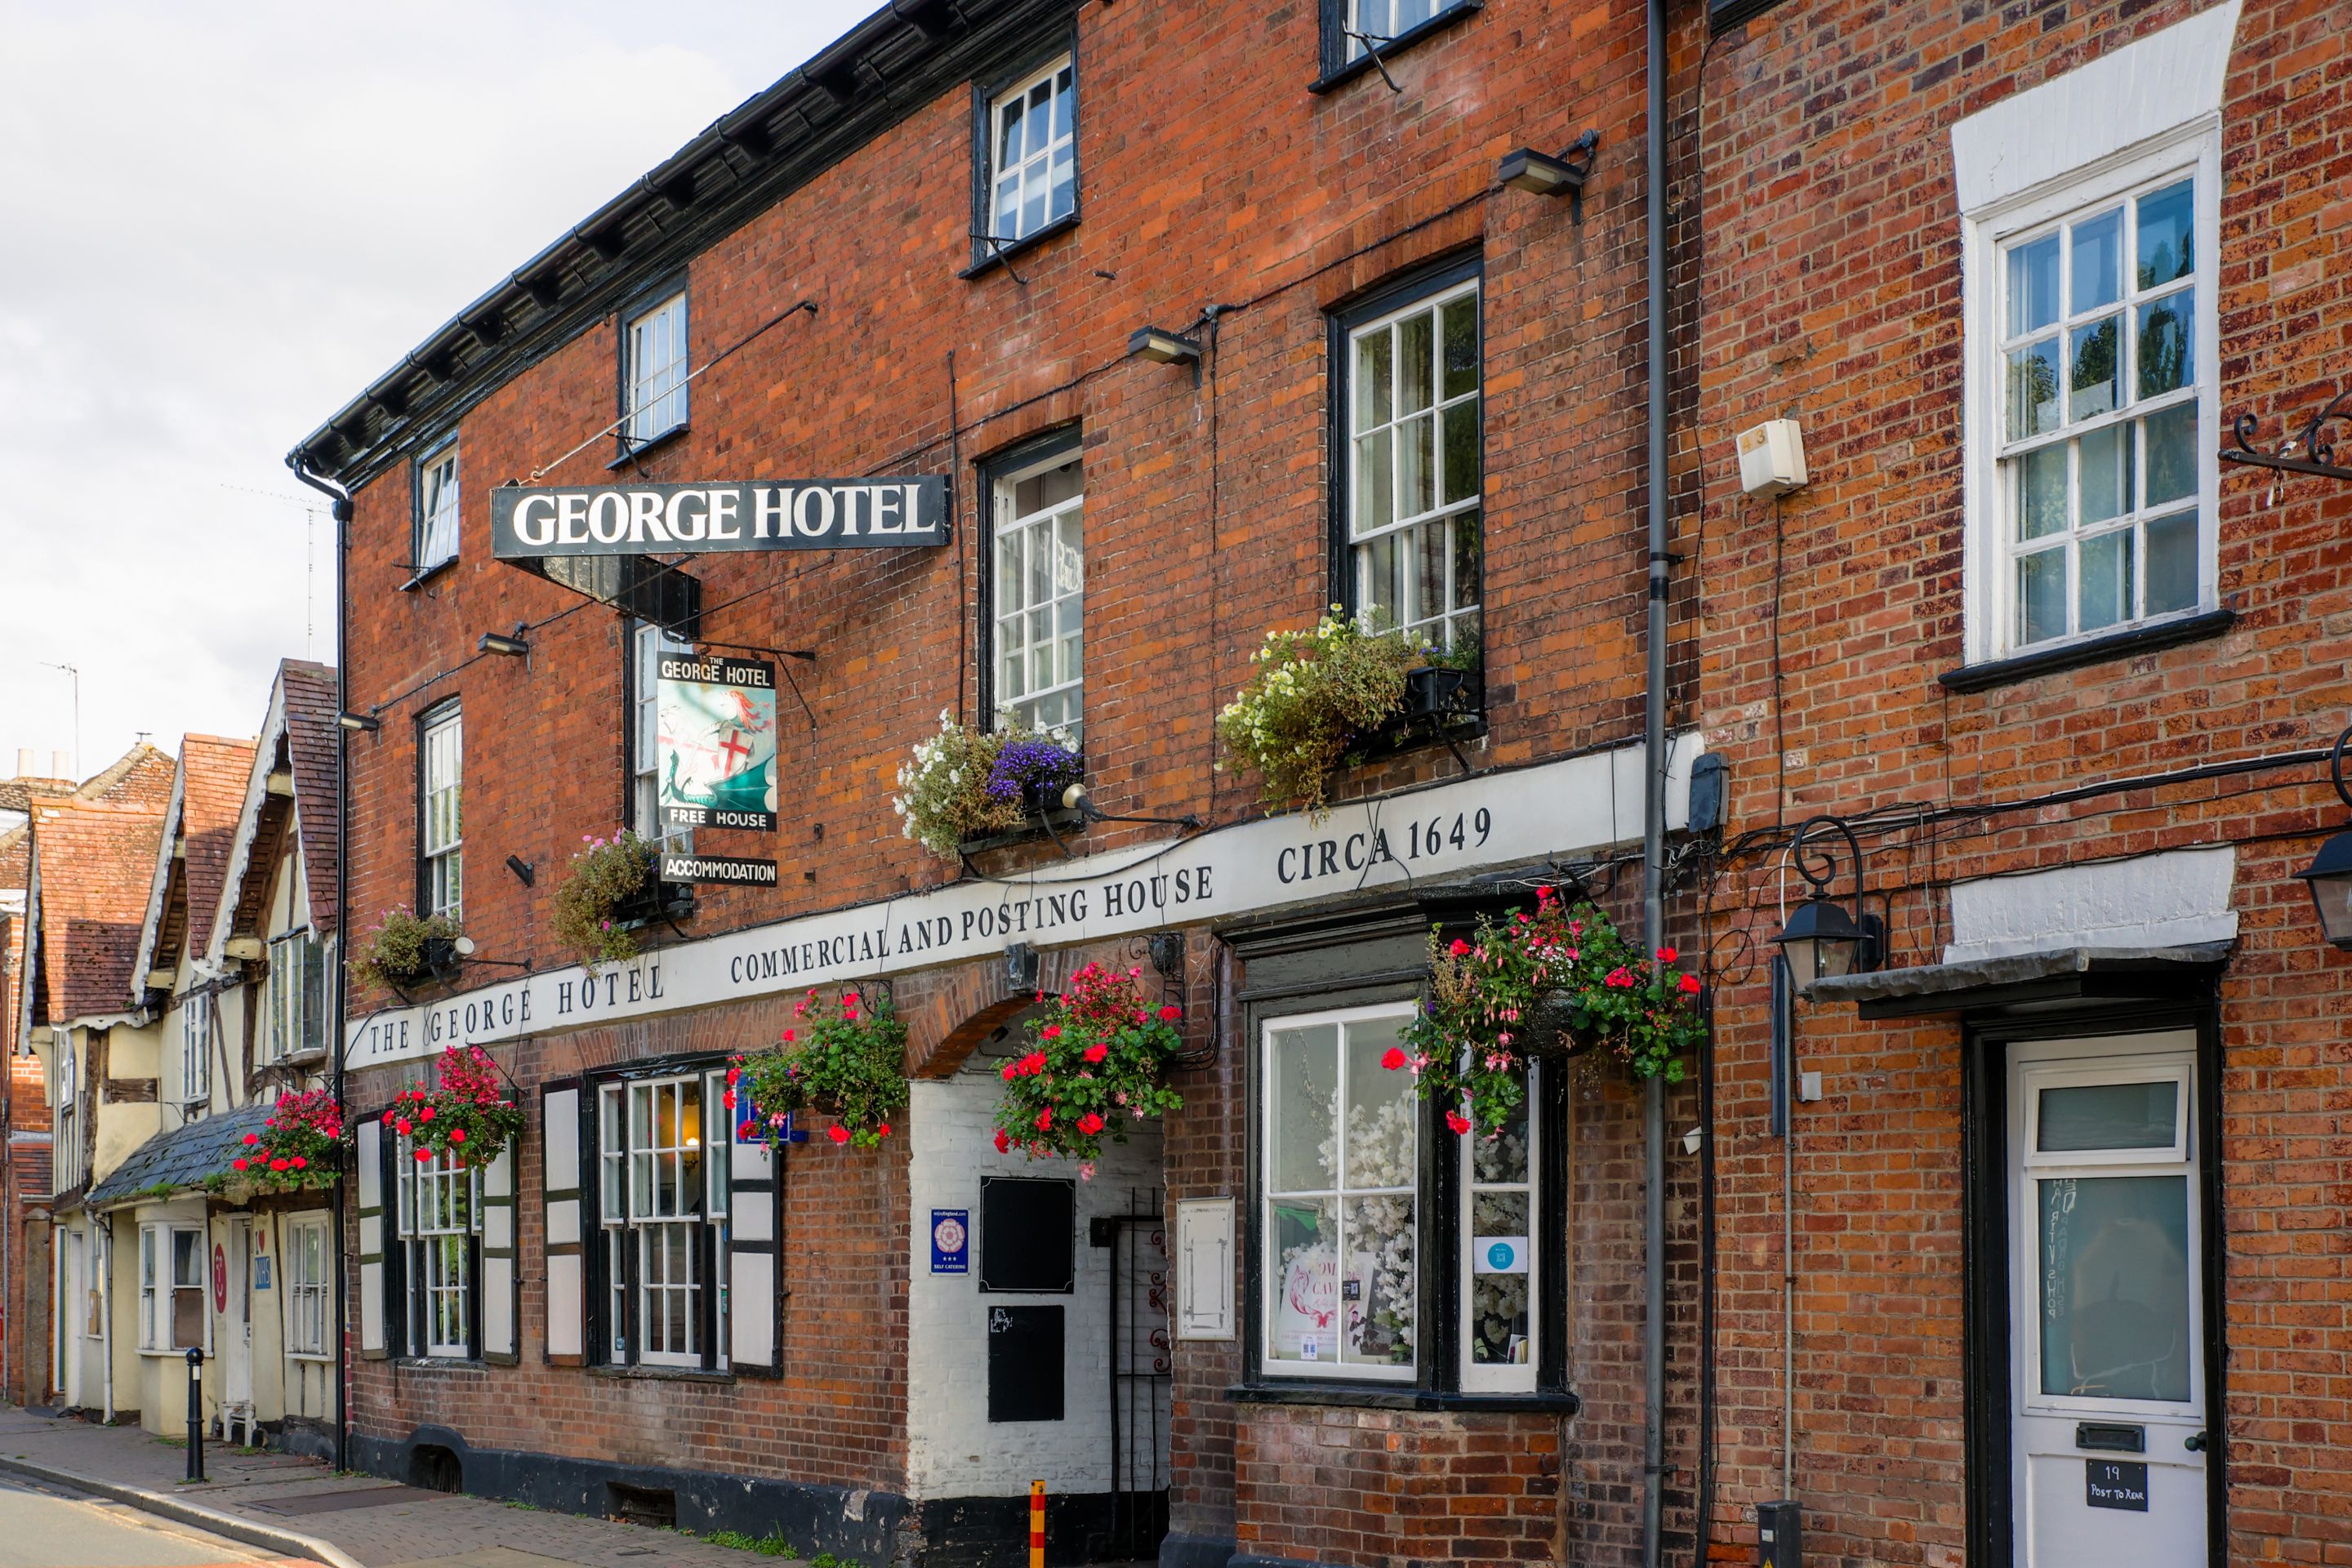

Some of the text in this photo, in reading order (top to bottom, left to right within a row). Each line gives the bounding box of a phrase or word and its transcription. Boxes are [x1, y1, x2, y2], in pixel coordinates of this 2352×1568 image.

[513, 483, 936, 546] GEORGE HOTEL
[709, 657, 724, 666] THE
[662, 660, 770, 687] GEORGE HOTEL
[670, 808, 767, 827] FREE HOUSE
[665, 858, 776, 881] ACCOMMODATION
[370, 806, 1491, 1054] THE GEORGE HOTEL COMMERCIAL AND POSTING HOUSE CIRCA 1649
[255, 1258, 270, 1285] NHS
[2105, 1465, 2120, 1481] 19
[2091, 1483, 2145, 1500] POST TO REAR
